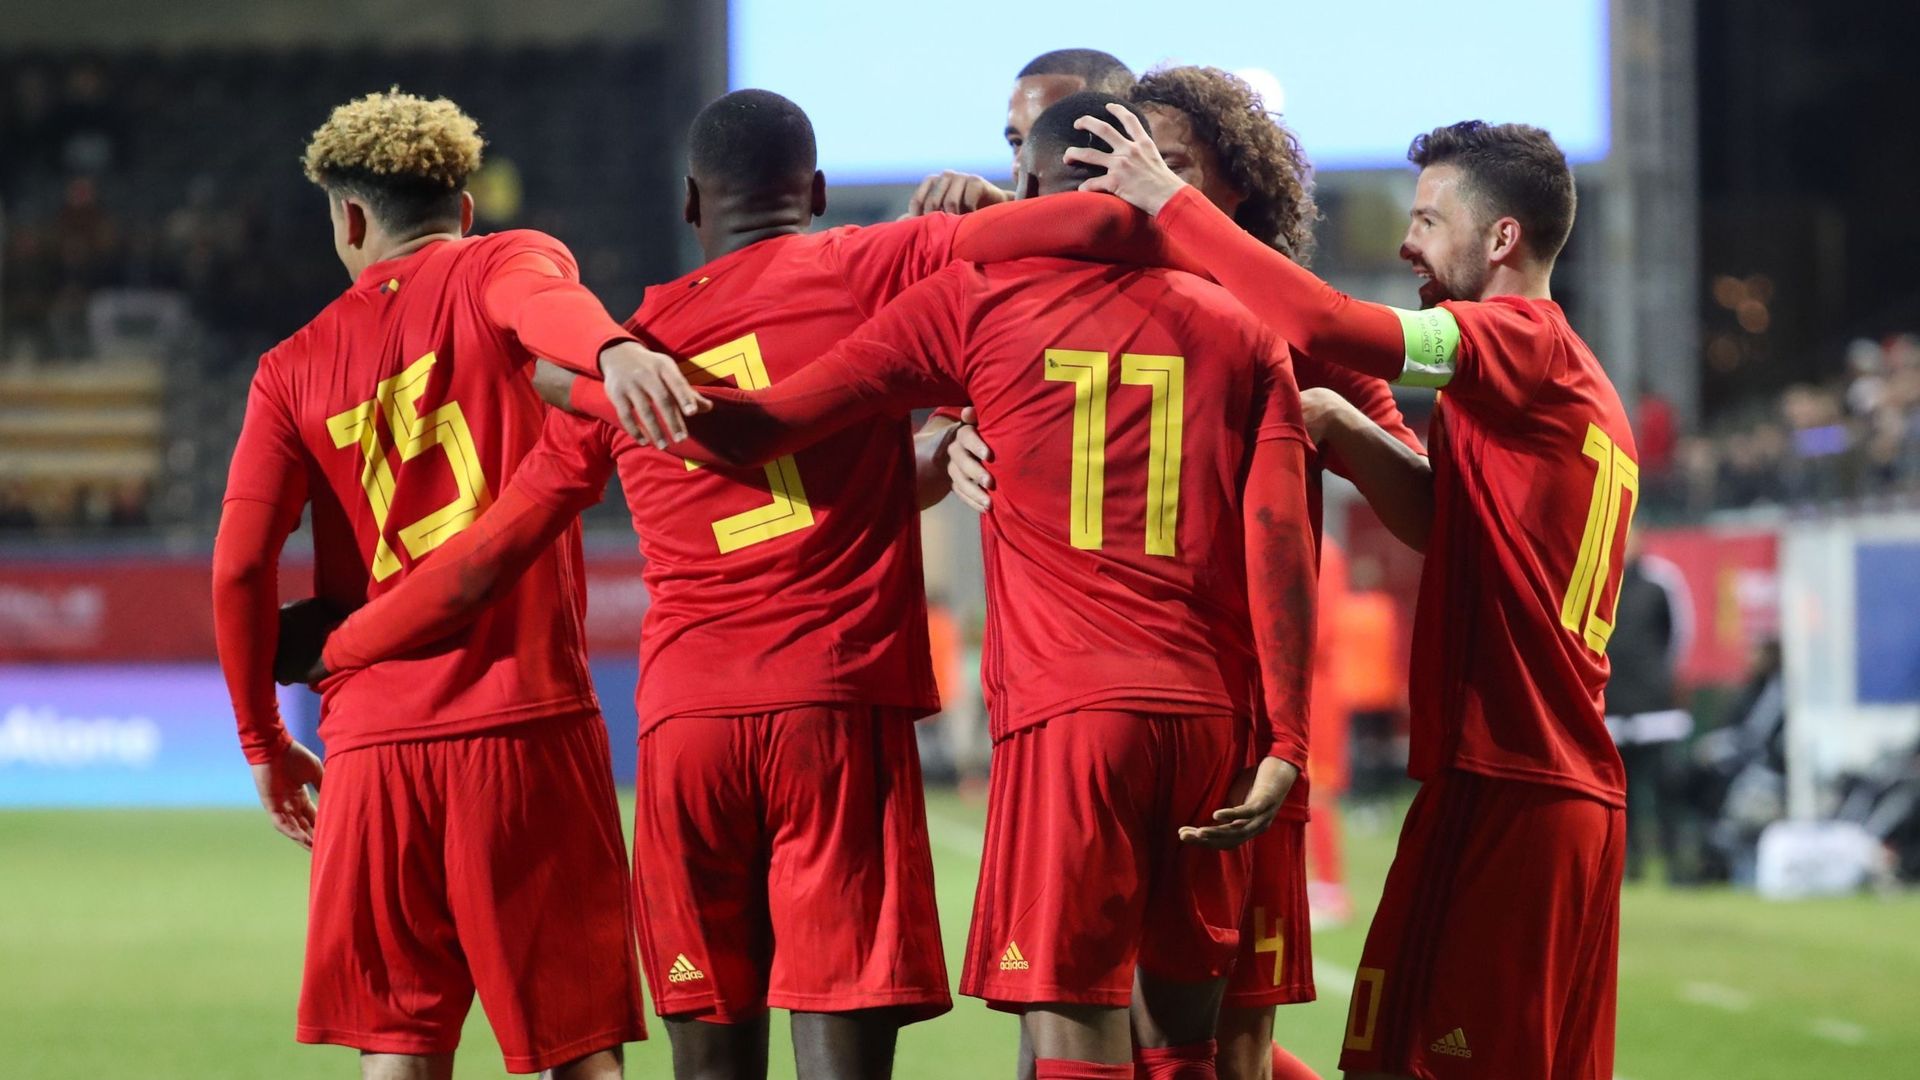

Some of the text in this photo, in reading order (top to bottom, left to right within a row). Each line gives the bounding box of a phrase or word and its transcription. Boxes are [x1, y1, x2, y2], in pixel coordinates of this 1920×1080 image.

[1434, 329, 1445, 368] RACIS
[326, 351, 493, 583] 15
[1044, 348, 1185, 557] 11
[1561, 421, 1639, 657] 10
[1000, 960, 1029, 970] adidas
[1254, 906, 1284, 986] 4
[668, 970, 704, 983] adidas
[1430, 1043, 1472, 1058] adidas
